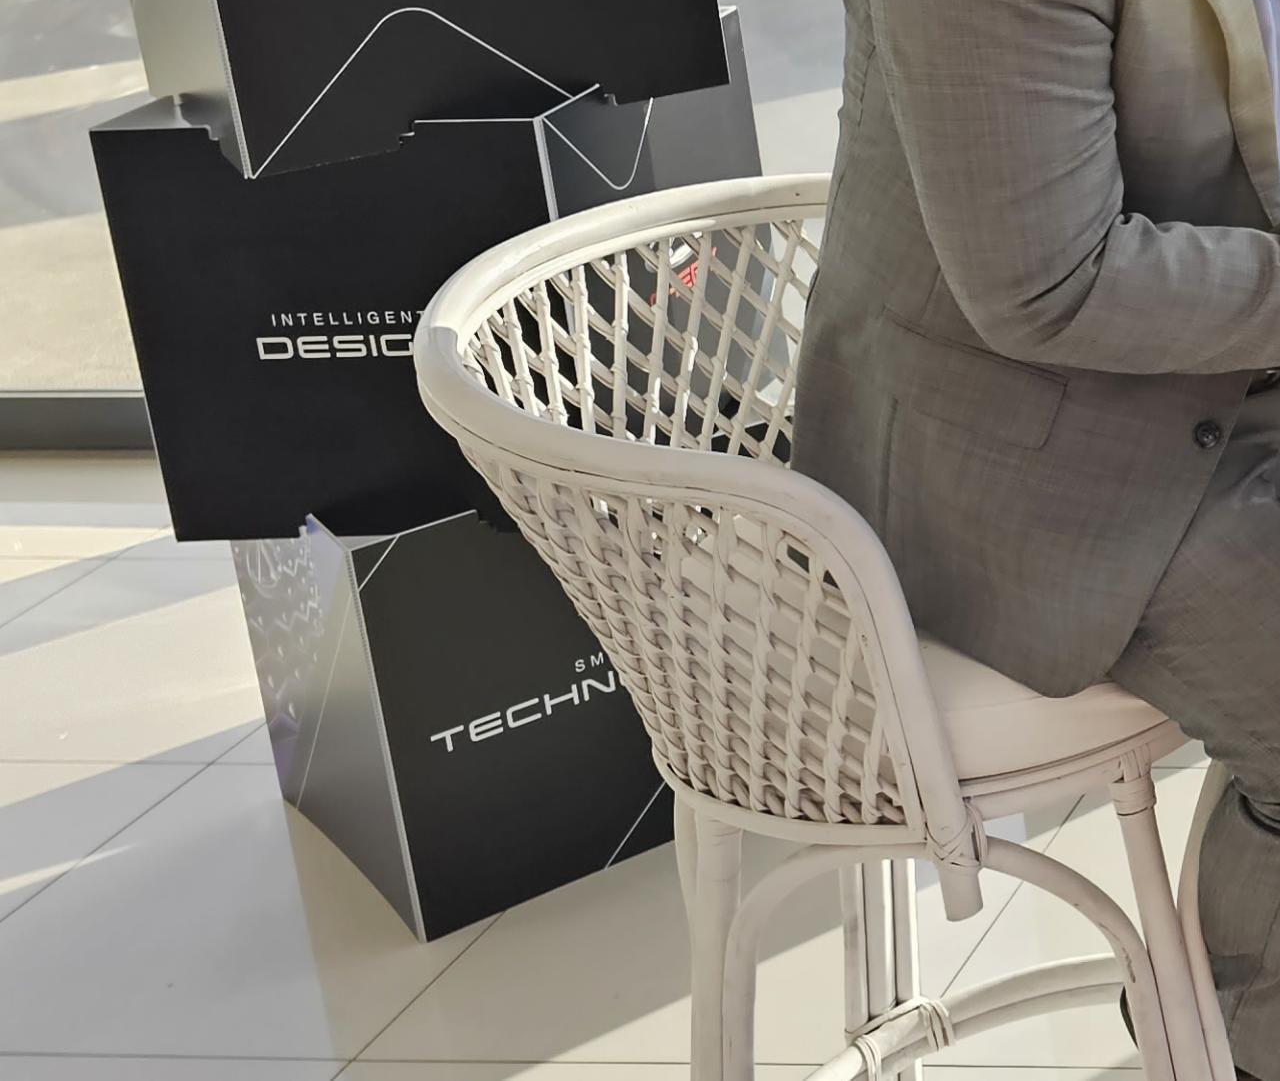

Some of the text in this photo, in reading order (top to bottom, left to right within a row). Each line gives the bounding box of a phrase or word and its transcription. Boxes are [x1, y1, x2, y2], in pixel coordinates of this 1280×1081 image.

[256, 333, 413, 360] DESIG
[574, 651, 605, 673] SM
[430, 670, 616, 753] TECHN
